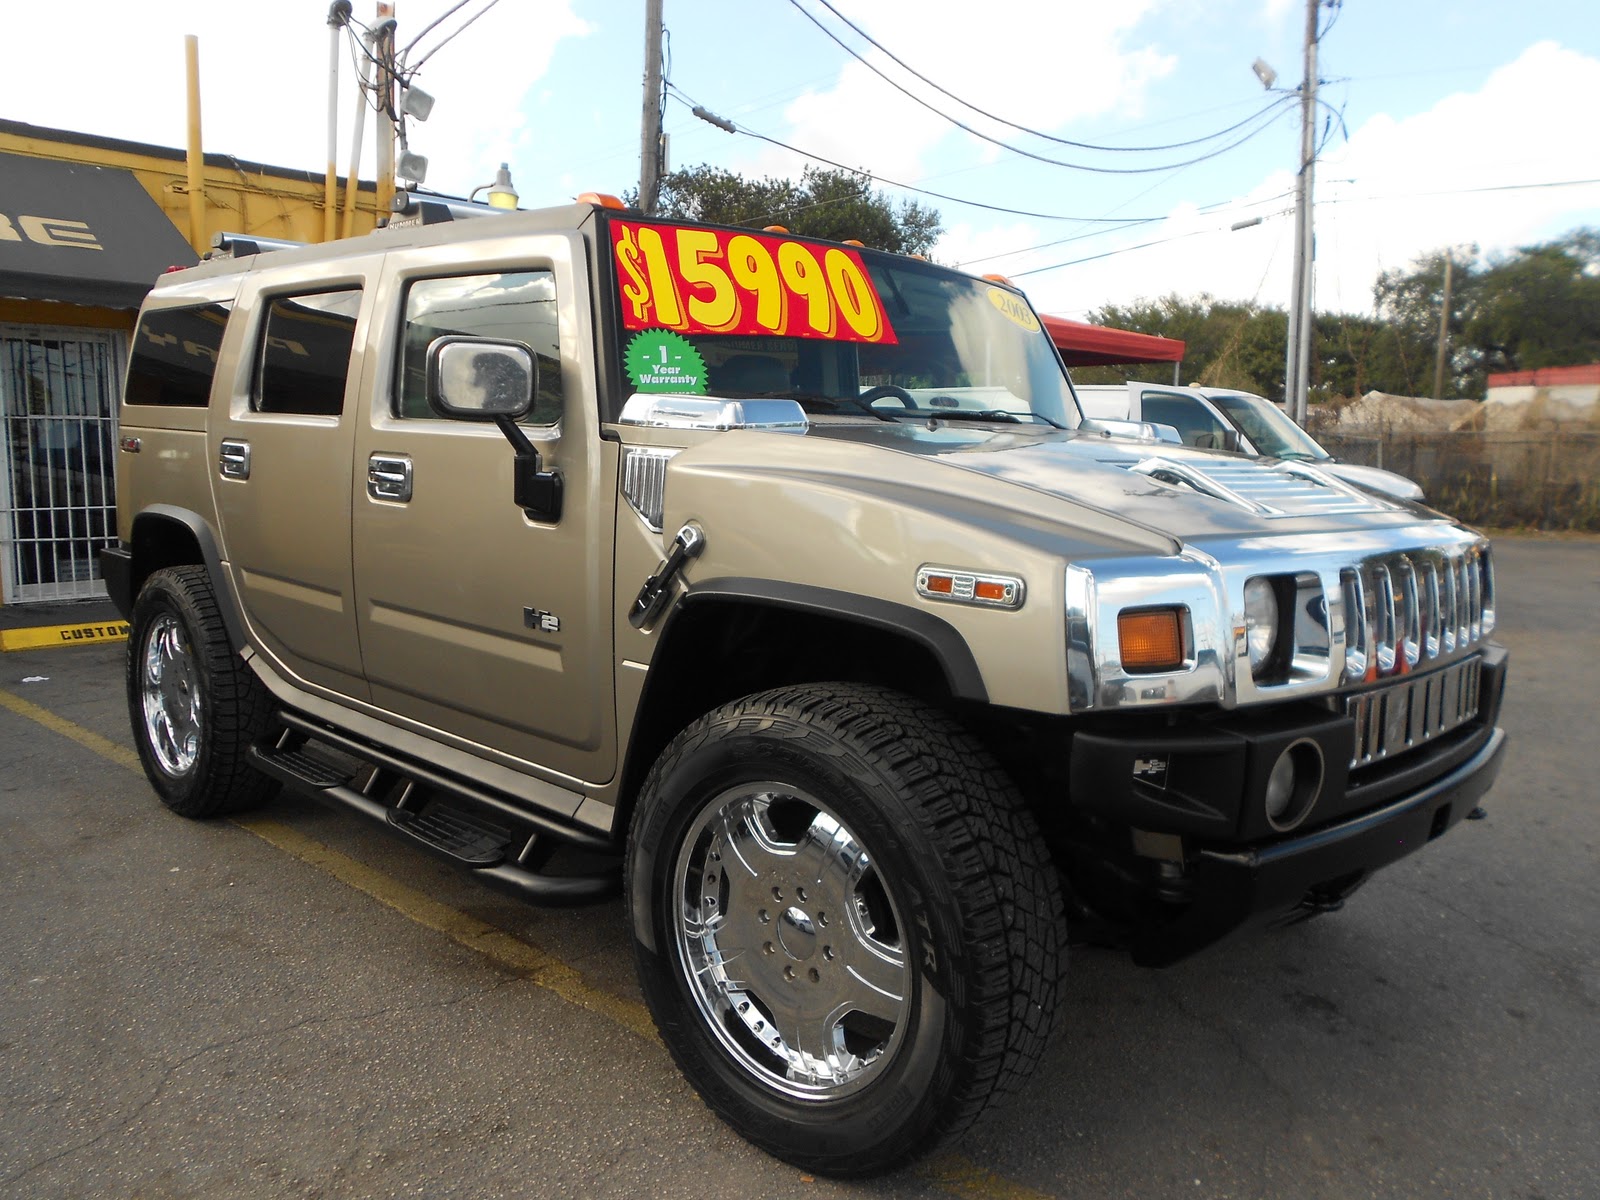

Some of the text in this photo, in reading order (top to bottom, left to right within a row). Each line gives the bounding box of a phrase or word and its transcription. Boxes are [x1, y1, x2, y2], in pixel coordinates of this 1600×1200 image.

[616, 224, 883, 341] $15990
[998, 293, 1031, 325] 2003
[639, 374, 698, 386] Warranty
[652, 364, 681, 375] Year
[523, 606, 560, 633] H2
[1133, 759, 1167, 775] H2
